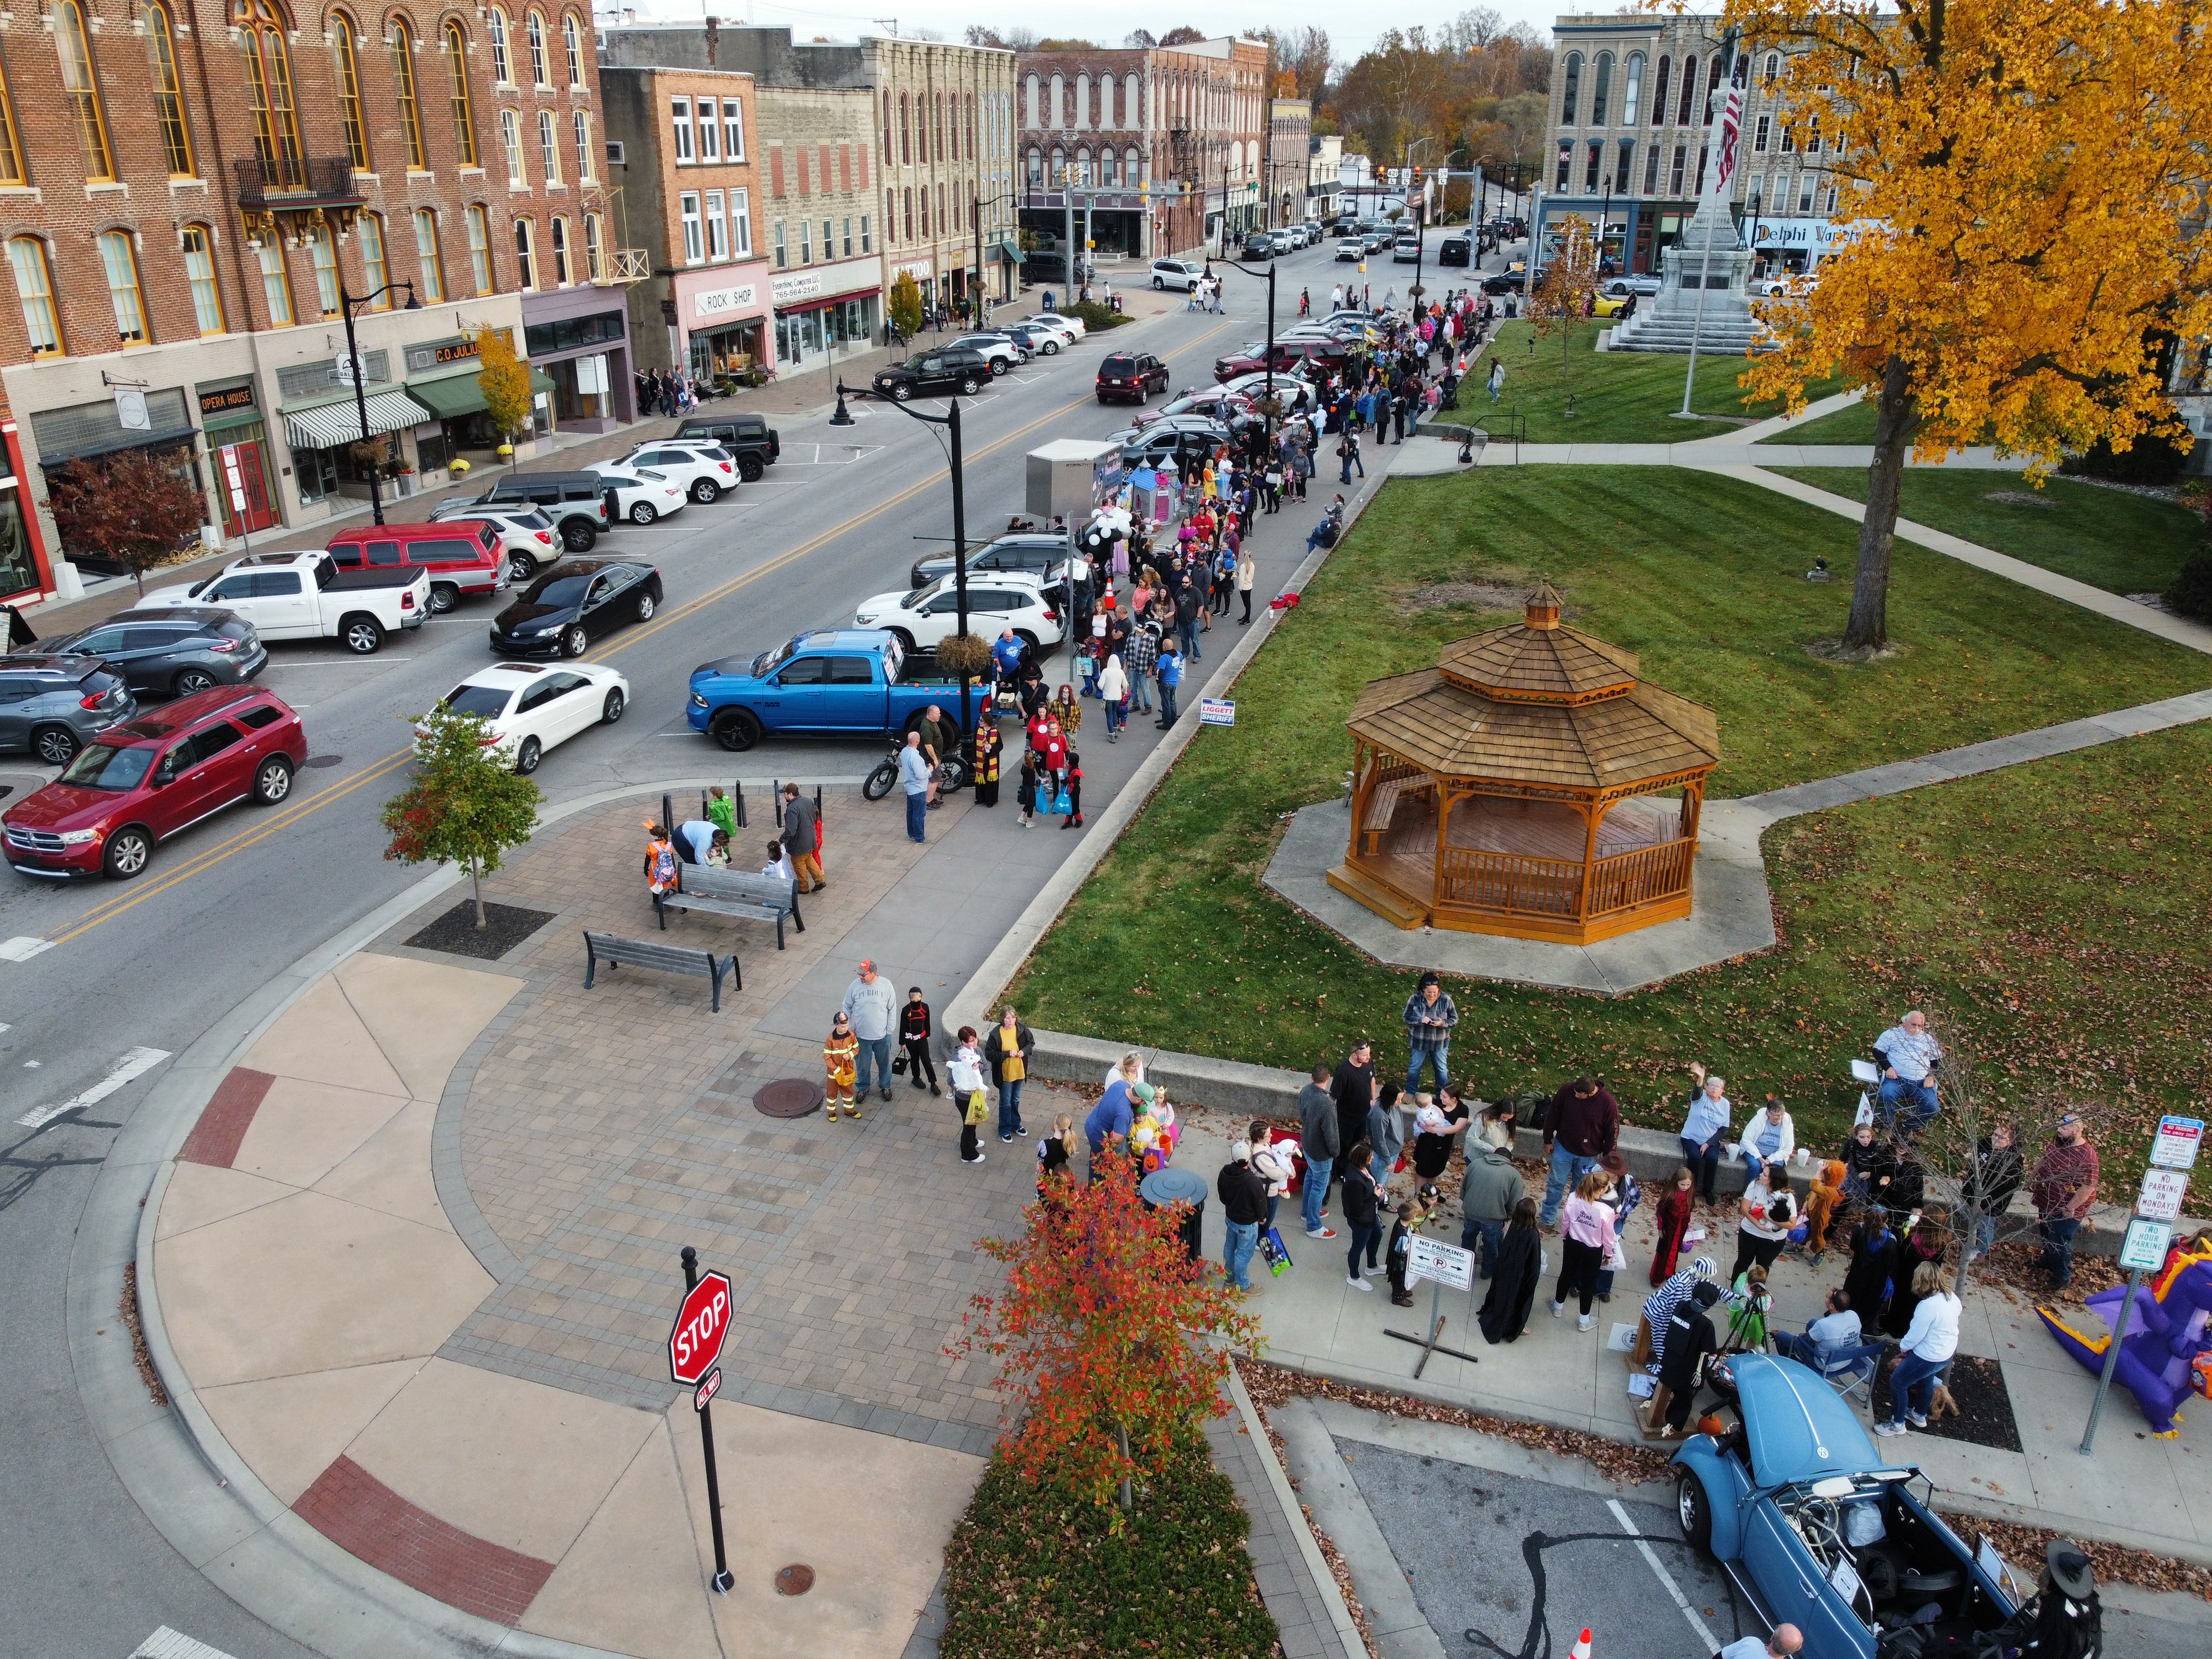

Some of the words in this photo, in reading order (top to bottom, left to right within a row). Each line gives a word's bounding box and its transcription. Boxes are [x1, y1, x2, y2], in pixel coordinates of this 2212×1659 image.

[1757, 225, 1807, 245] Delphi
[893, 261, 930, 281] TATTOO
[812, 274, 820, 283] LLC
[775, 285, 819, 299] 765-564-2140
[707, 293, 728, 310] ROCK
[734, 289, 752, 304] SHOP
[201, 396, 225, 410] OPERA
[227, 391, 251, 405] HOUSE
[1202, 706, 1234, 714] LIGGETT
[1202, 714, 1233, 722] SHERIFF
[2148, 1182, 2179, 1193] PARKING
[2142, 1199, 2176, 1211] MONDAYS
[2138, 1233, 2159, 1241] HOUR
[1432, 1244, 1464, 1258] PARKING
[2131, 1239, 2163, 1250] PARKING
[1442, 1253, 1467, 1263] DEPARTMENT
[677, 1291, 726, 1366] STOP
[1672, 1315, 1690, 1329] PINKARD
[698, 1390, 708, 1406] ALL
[707, 1374, 718, 1394] WAY
